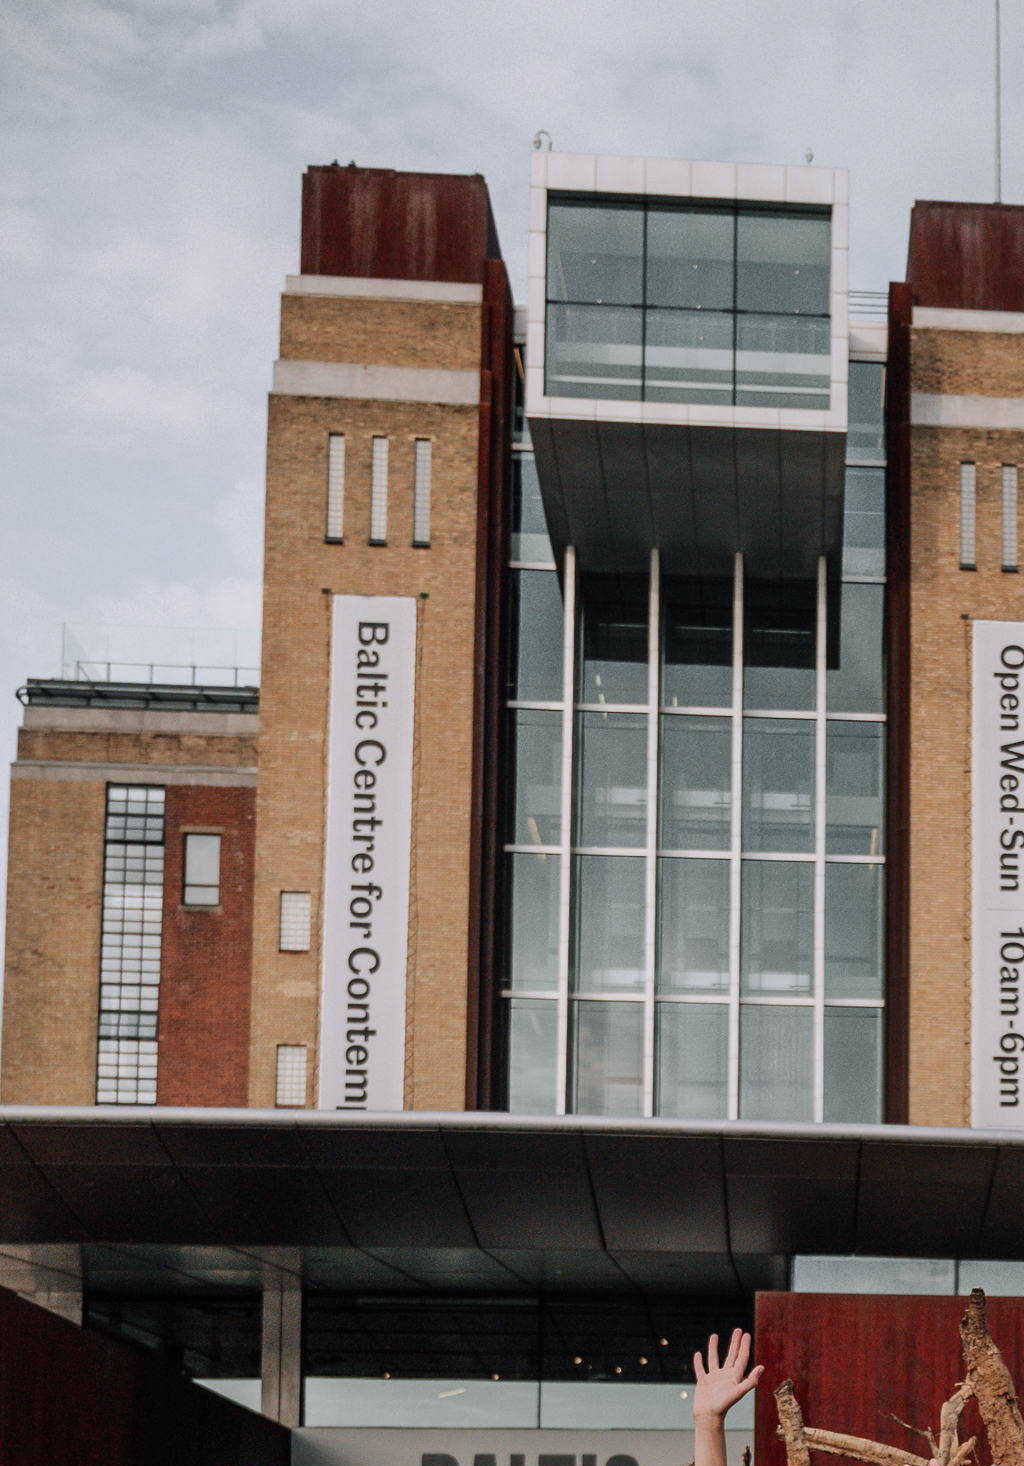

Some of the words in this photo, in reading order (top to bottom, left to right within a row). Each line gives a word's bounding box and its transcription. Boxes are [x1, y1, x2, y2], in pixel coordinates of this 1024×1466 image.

[354, 621, 390, 730] Baltic
[351, 739, 387, 874] Centre
[350, 881, 383, 939] for
